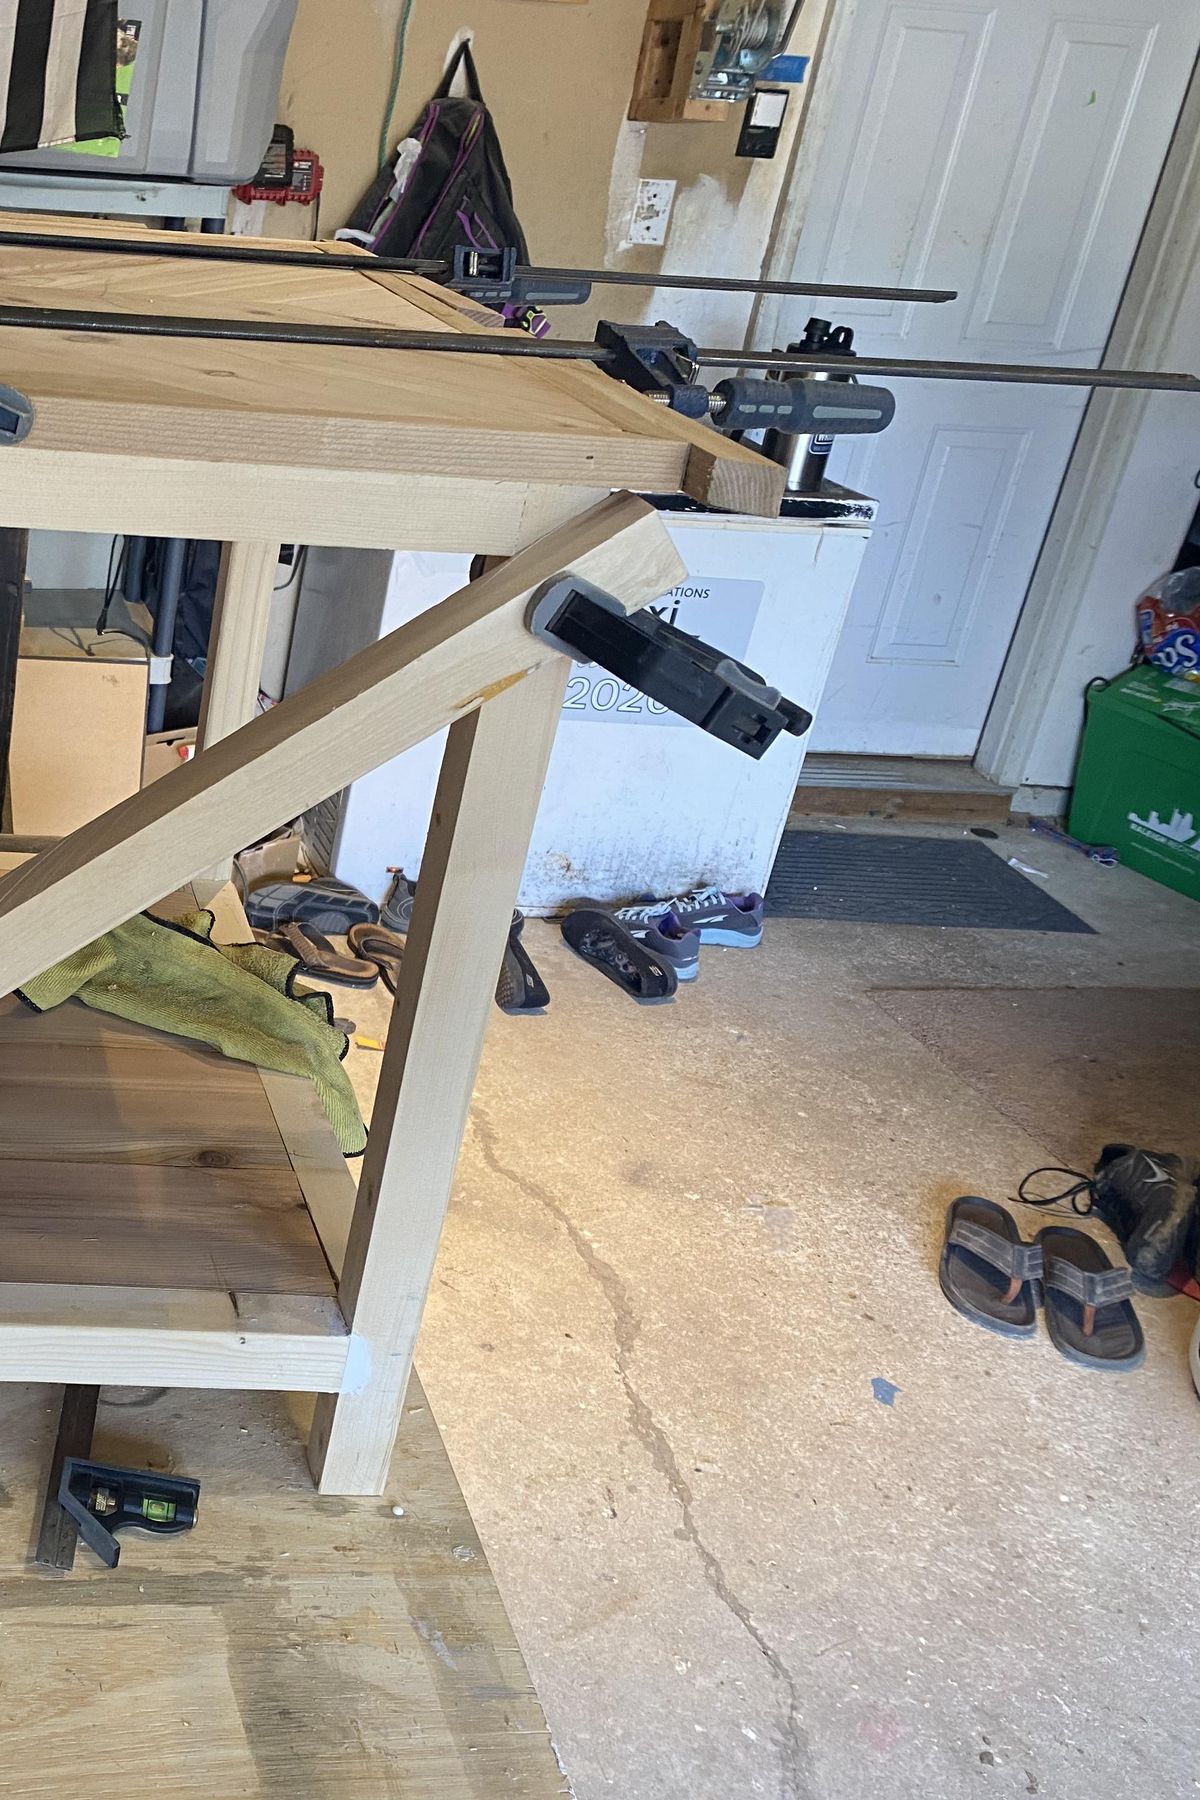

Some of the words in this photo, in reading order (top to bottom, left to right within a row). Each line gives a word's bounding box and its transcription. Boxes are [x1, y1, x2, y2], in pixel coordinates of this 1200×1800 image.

[665, 587, 711, 599] ATIONS
[648, 599, 681, 627] xi
[1152, 634, 1198, 668] Sa
